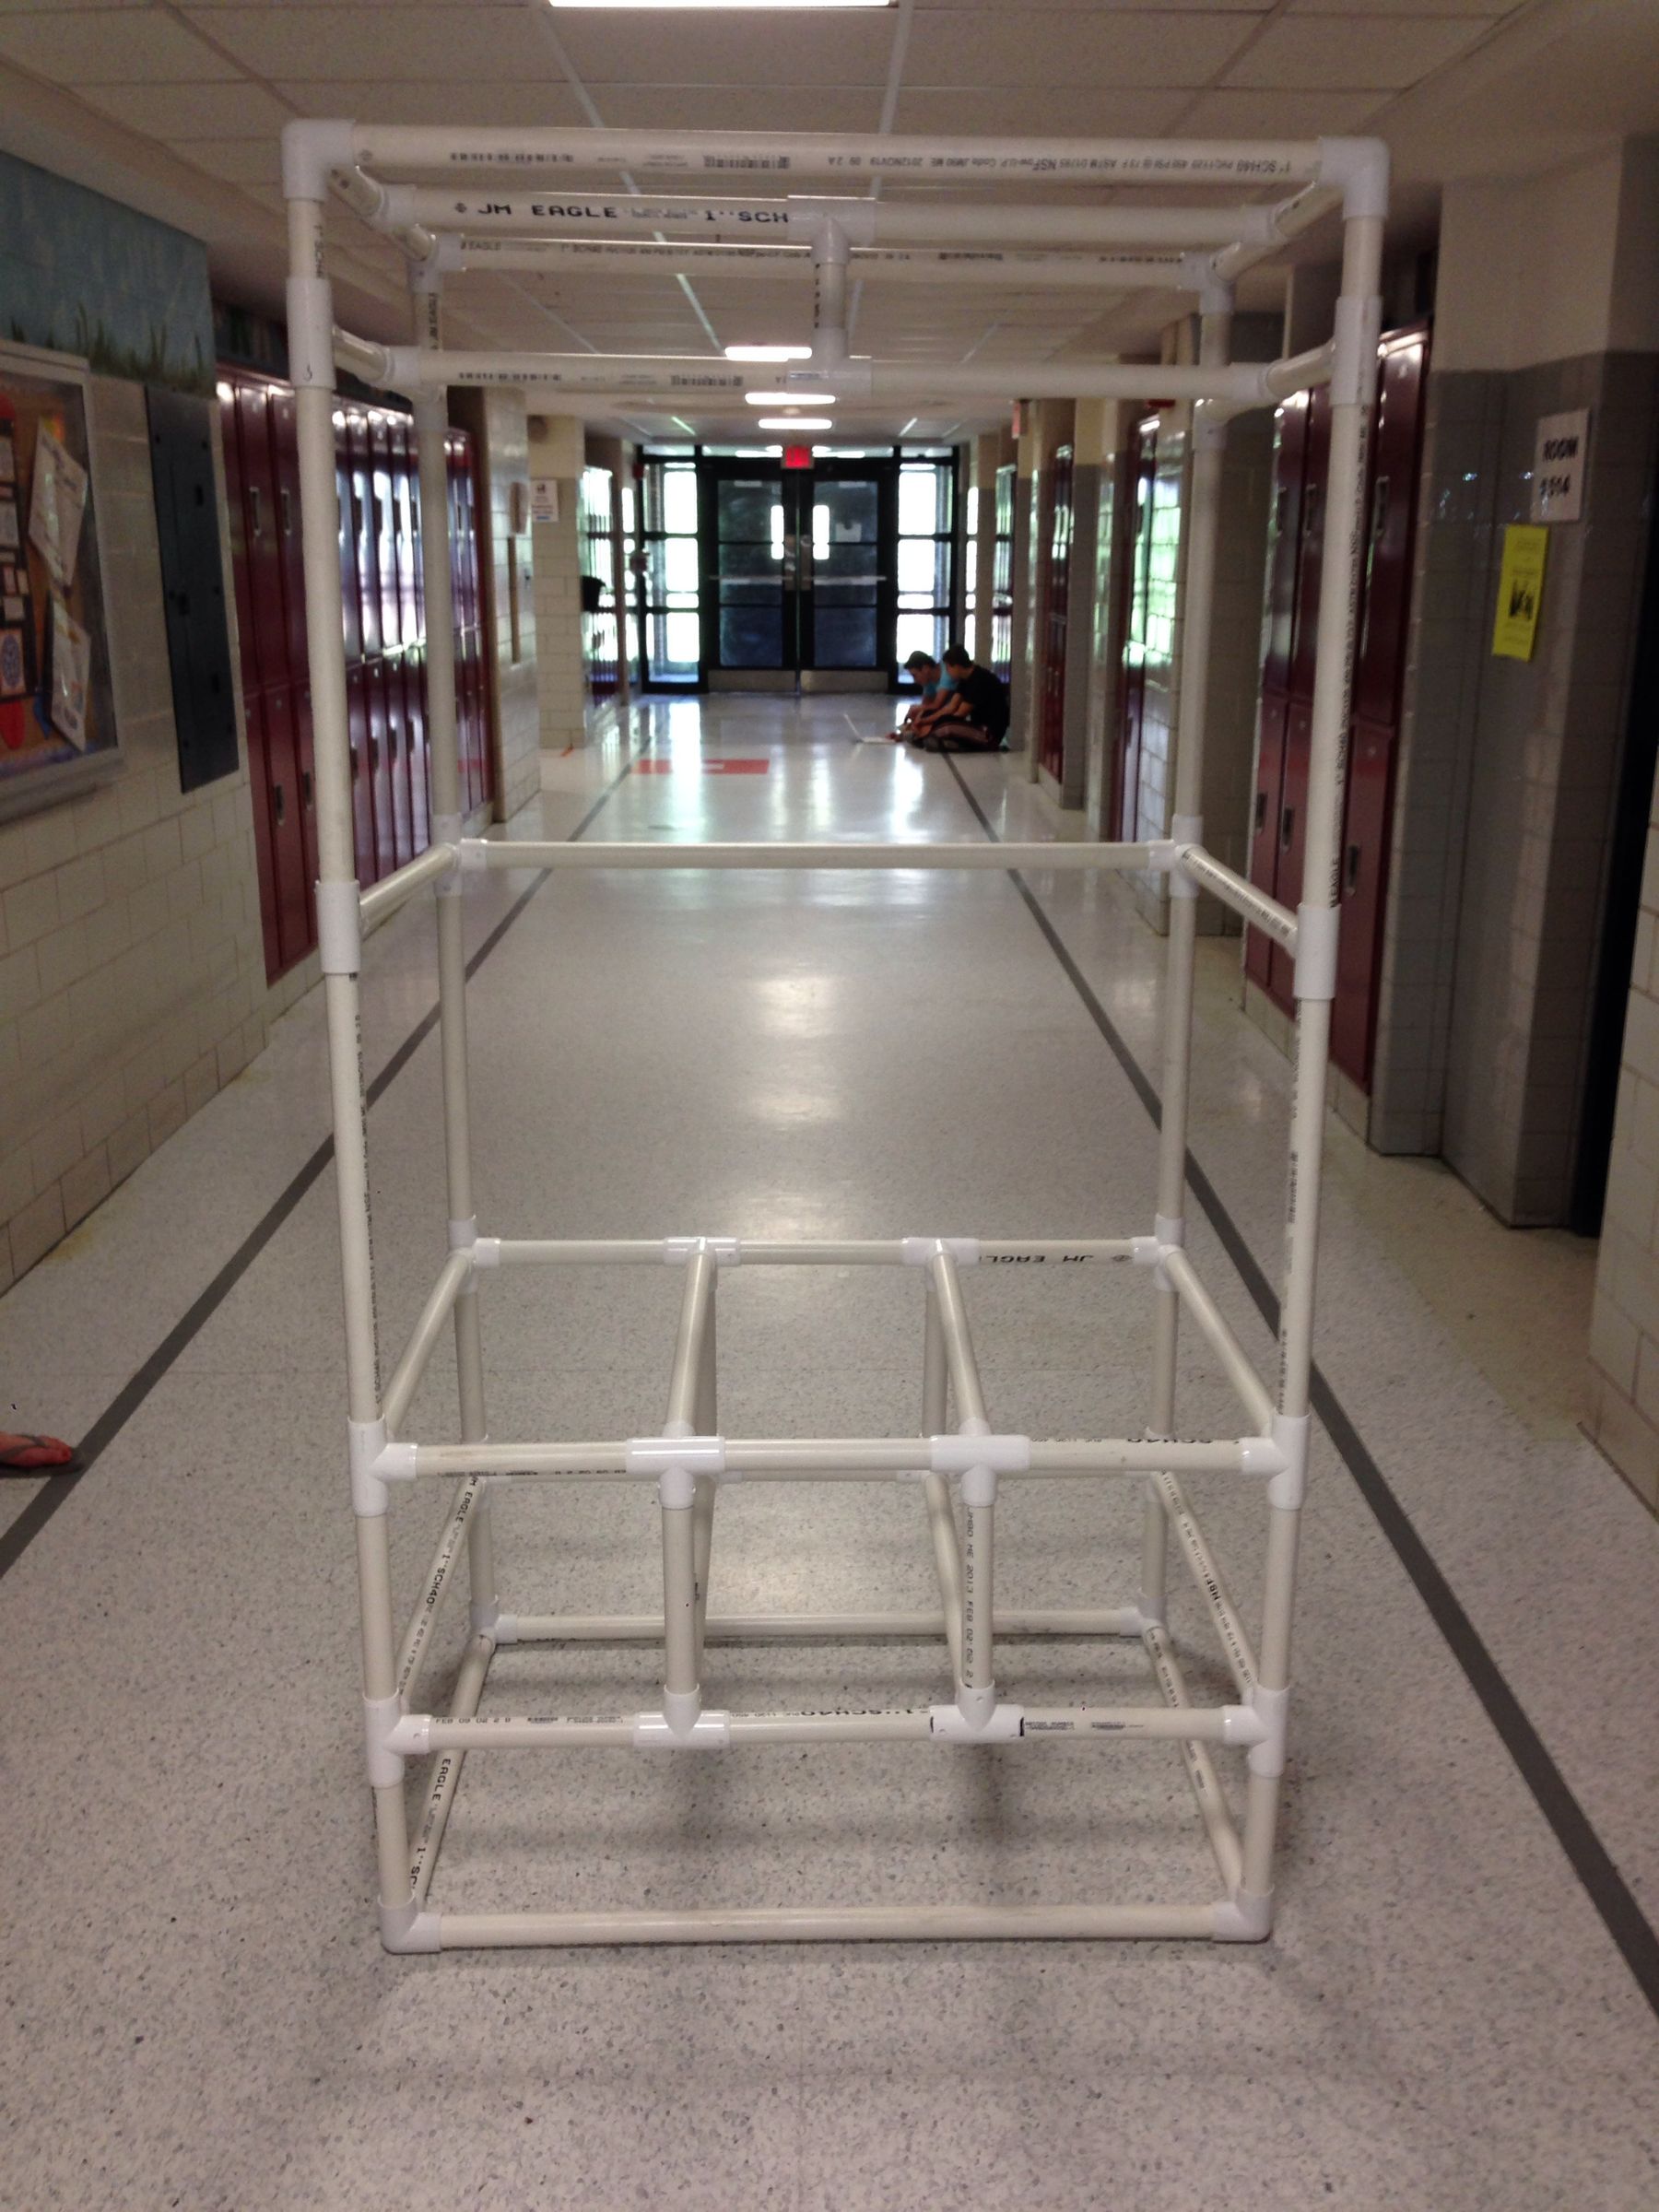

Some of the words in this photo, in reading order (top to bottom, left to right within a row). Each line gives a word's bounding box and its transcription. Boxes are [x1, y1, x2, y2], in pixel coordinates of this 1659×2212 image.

[477, 203, 511, 215] JM
[531, 204, 616, 218] EAGLE
[979, 1254, 1045, 1264] EAGL
[1063, 1254, 1094, 1263] JM
[453, 1490, 472, 1524] EAGLE
[431, 1756, 451, 1802] EAGLE
